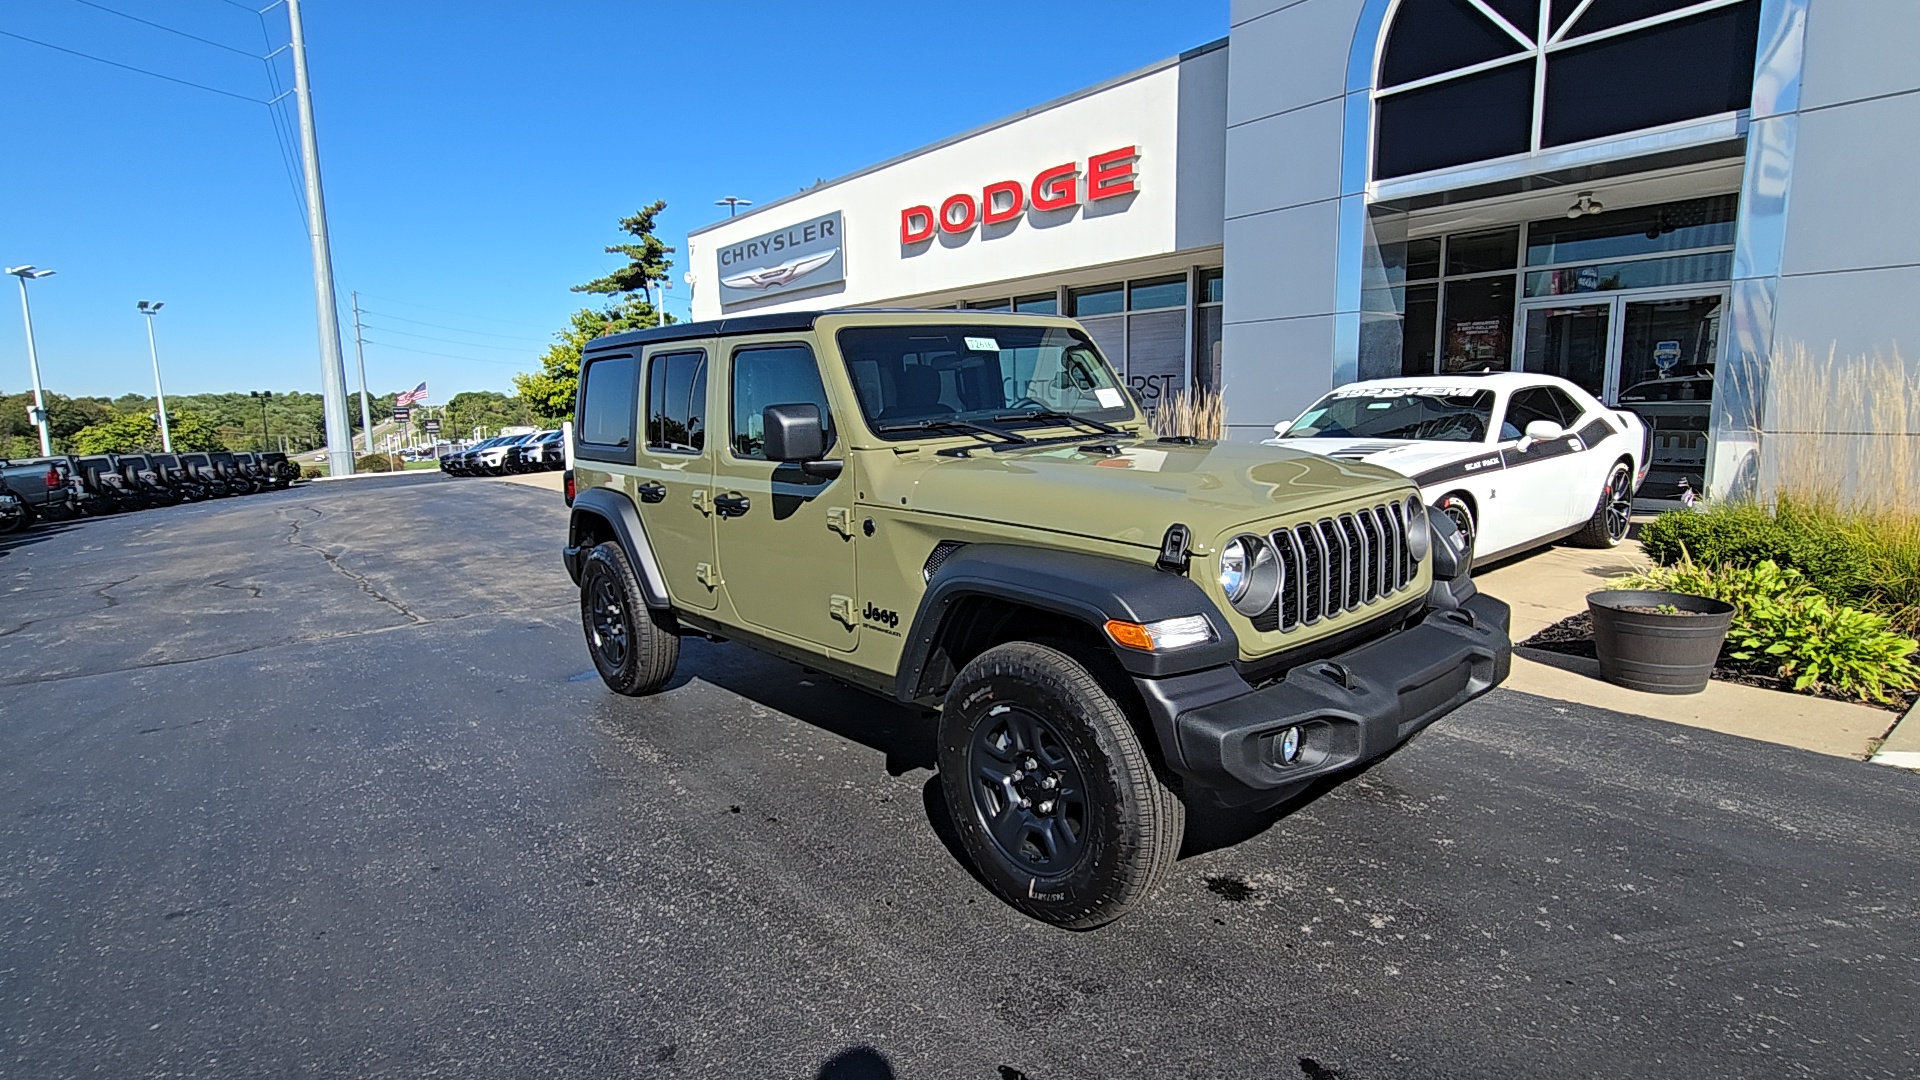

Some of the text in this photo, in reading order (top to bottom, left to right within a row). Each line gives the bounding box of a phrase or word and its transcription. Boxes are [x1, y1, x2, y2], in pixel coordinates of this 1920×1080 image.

[901, 145, 1138, 246] DODGE
[721, 219, 835, 266] CHRYSLER
[862, 601, 899, 629] Jeep
